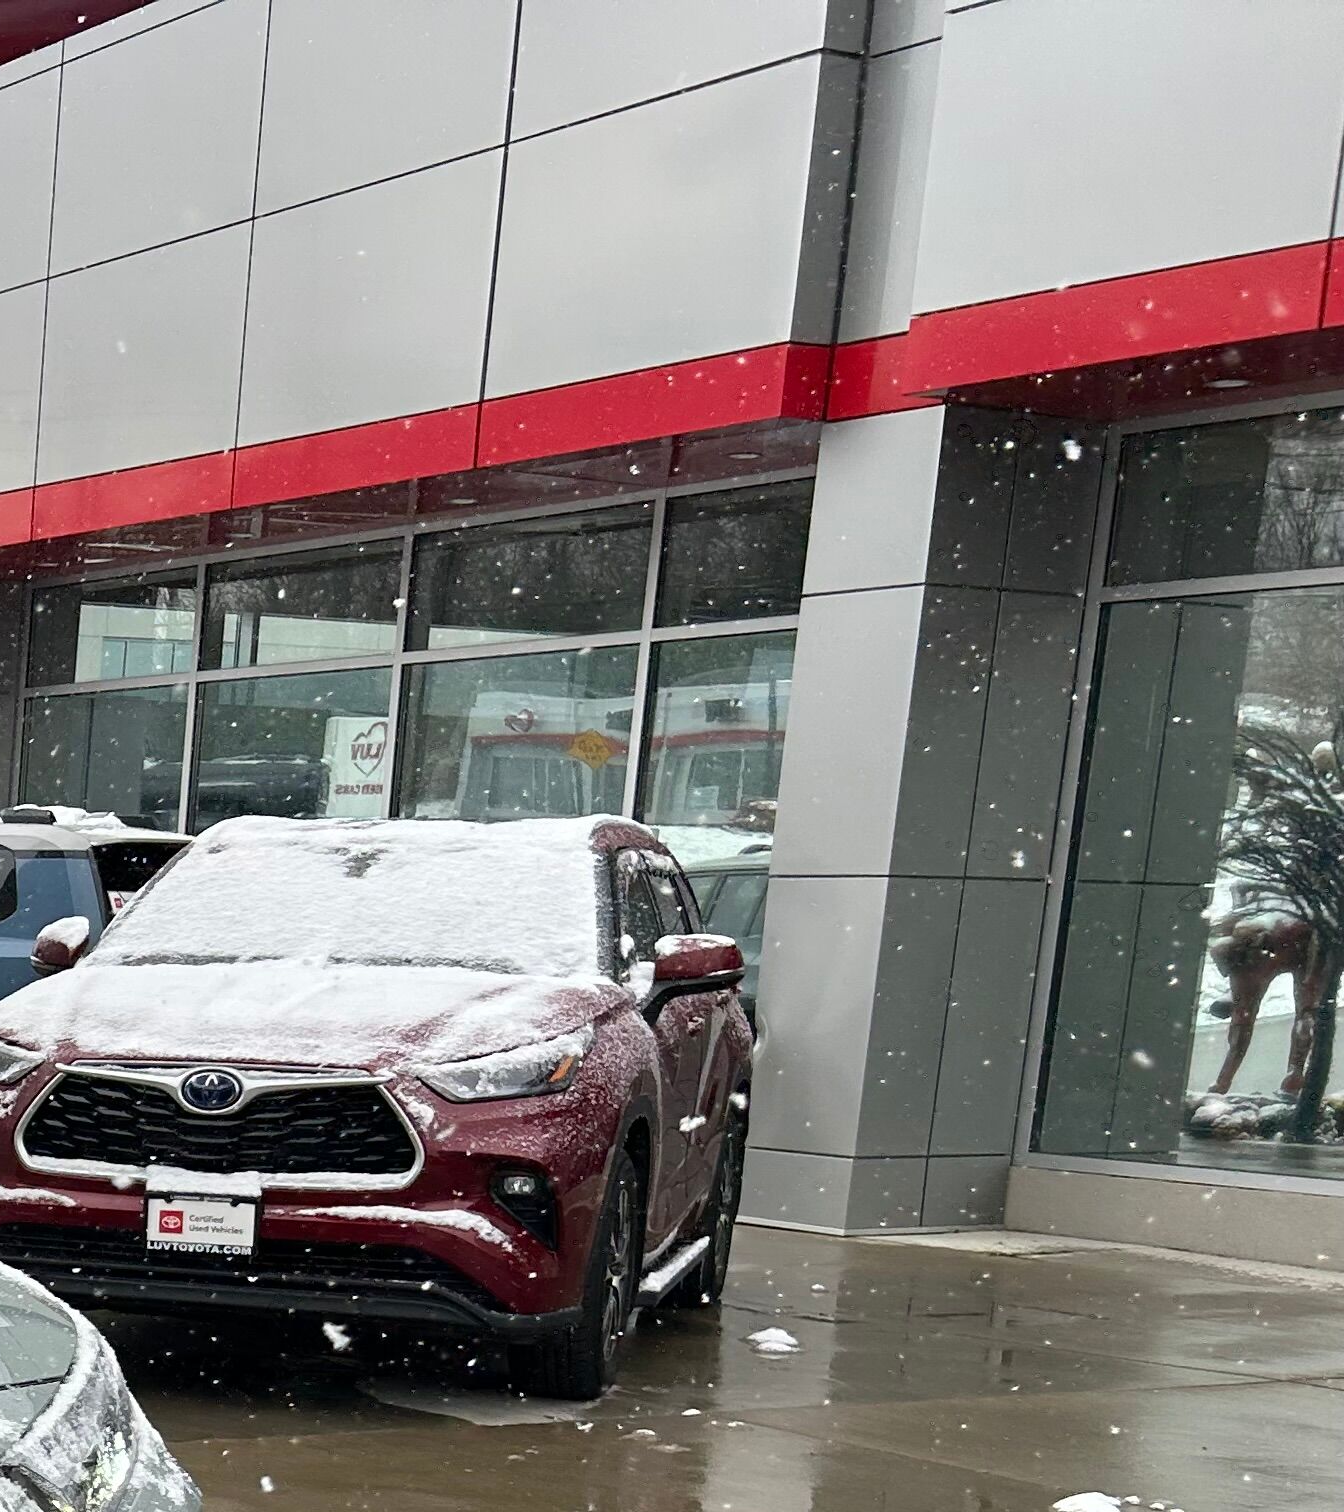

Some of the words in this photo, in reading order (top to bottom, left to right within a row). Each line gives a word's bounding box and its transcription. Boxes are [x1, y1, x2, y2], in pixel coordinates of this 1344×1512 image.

[189, 1214, 224, 1224] Certified
[211, 1225, 243, 1234] Vehicles
[146, 1241, 252, 1255] LUVTOYOTA.COM
